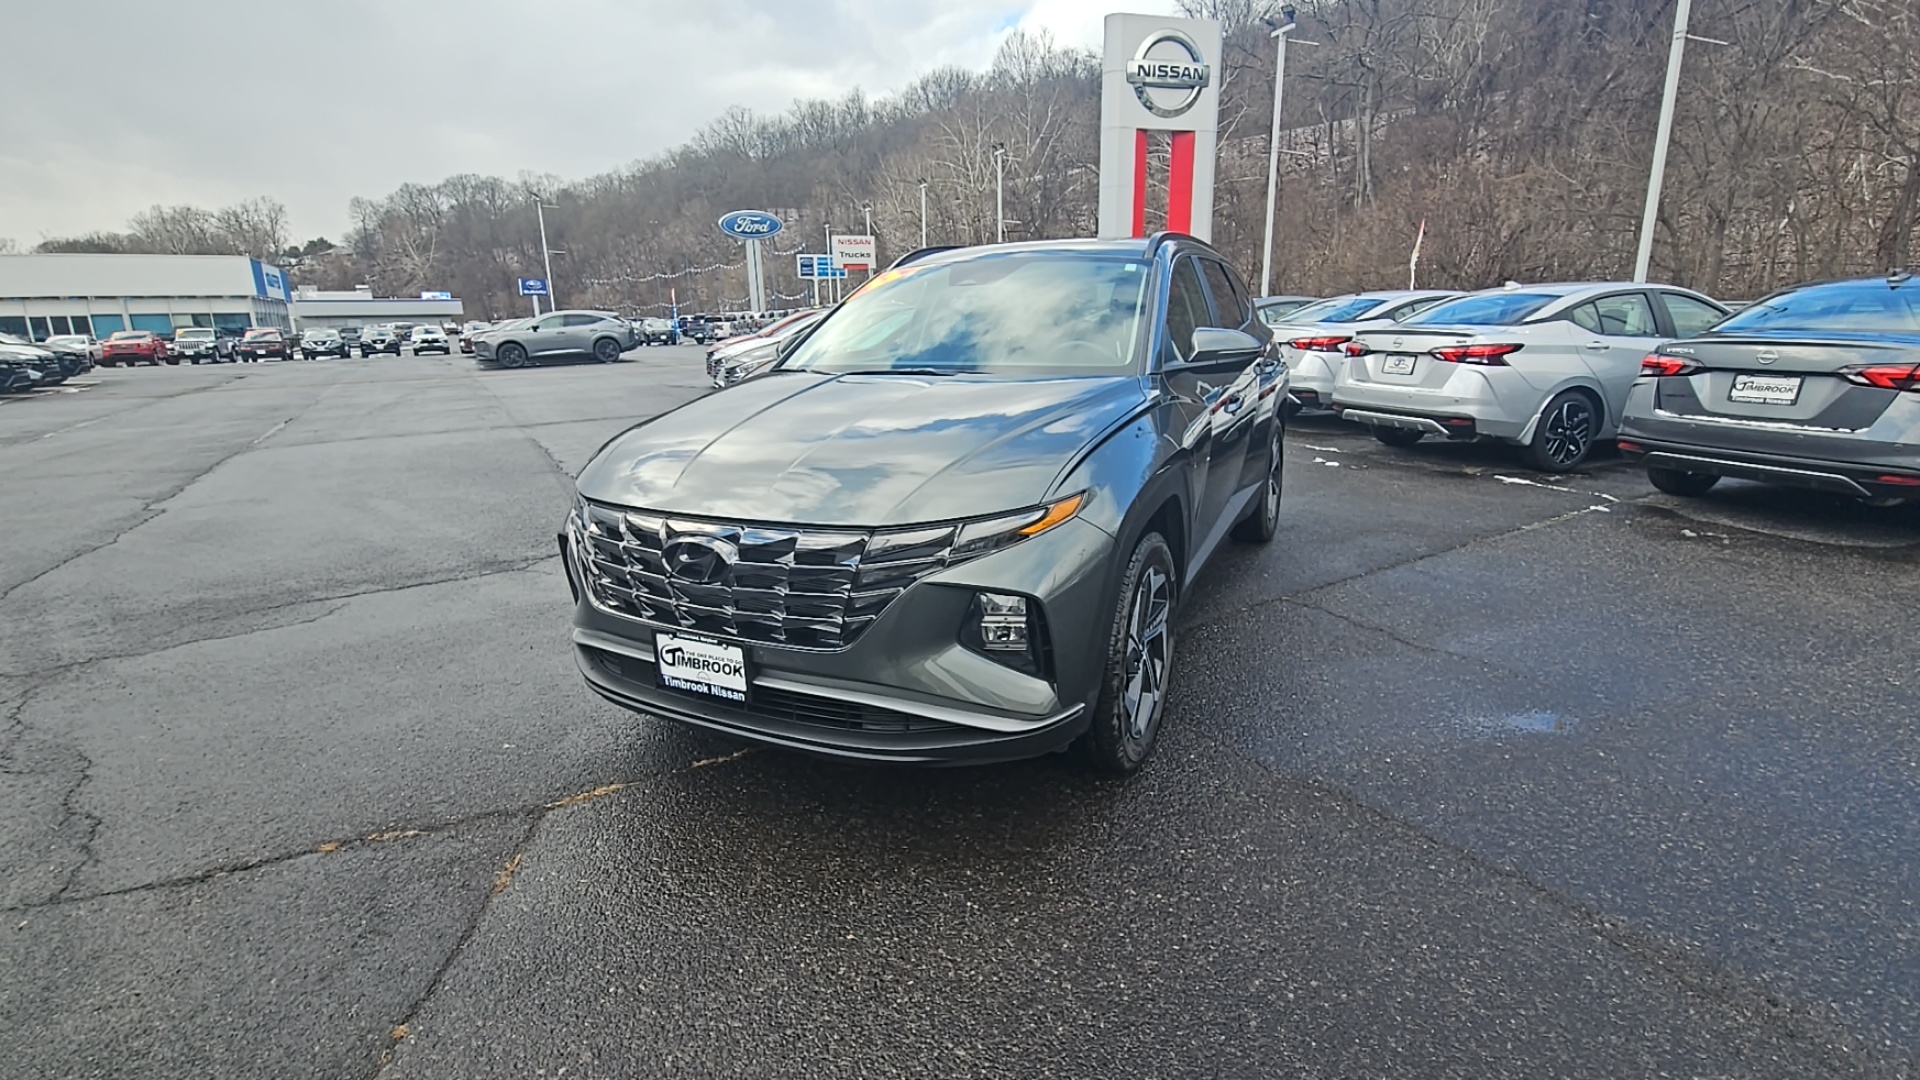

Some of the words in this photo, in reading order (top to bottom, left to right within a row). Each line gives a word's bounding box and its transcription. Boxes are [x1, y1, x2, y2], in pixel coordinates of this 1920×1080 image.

[1137, 64, 1204, 80] NISSAN
[734, 217, 770, 233] Ford
[837, 238, 872, 246] NISSAN
[839, 251, 872, 259] Trucks
[1733, 381, 1796, 394] TIMBROOK
[661, 644, 743, 678] TIMBROOK
[663, 675, 709, 694] Timbrook
[711, 685, 746, 702] Nissan
